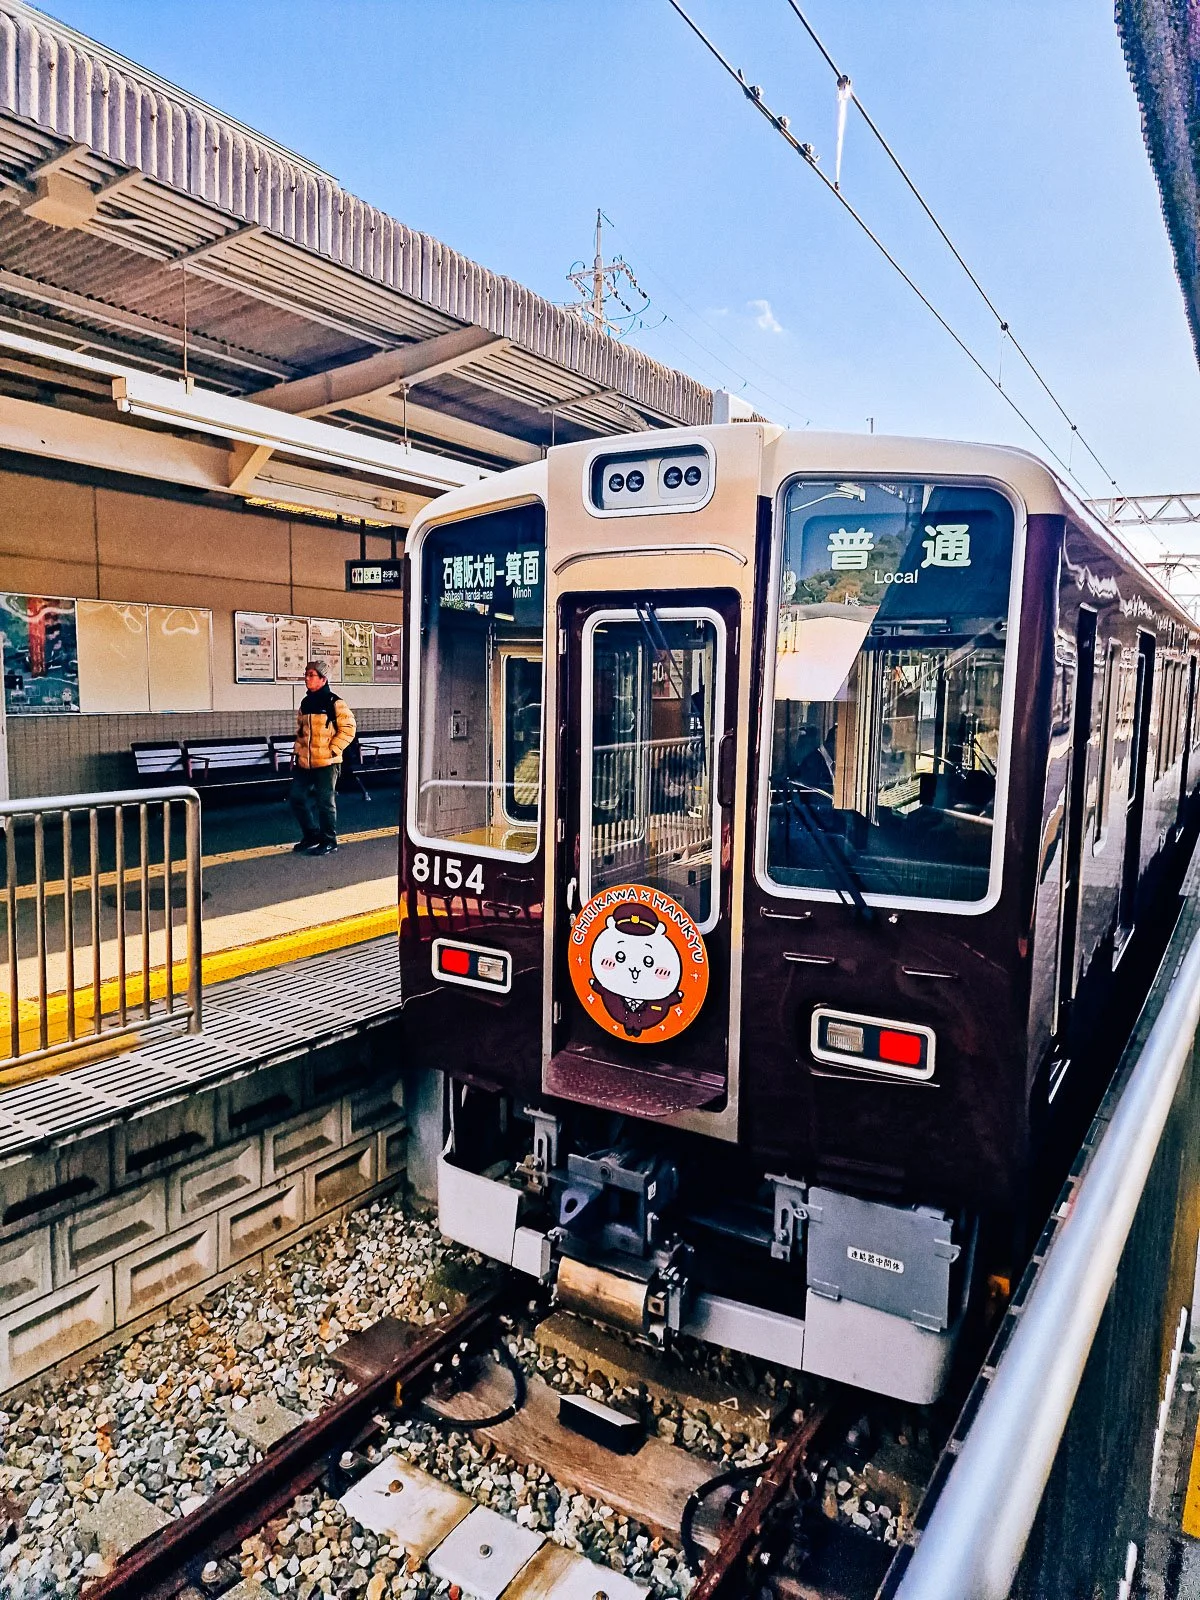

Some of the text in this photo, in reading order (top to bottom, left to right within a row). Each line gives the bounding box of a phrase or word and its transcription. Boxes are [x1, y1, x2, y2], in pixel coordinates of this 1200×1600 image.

[826, 524, 972, 570] 普通
[512, 586, 532, 599] Minoh
[874, 569, 919, 585] Local
[412, 852, 485, 895] 8154
[572, 887, 638, 946] CHIIKAWA
[652, 892, 705, 964] HANKYU
